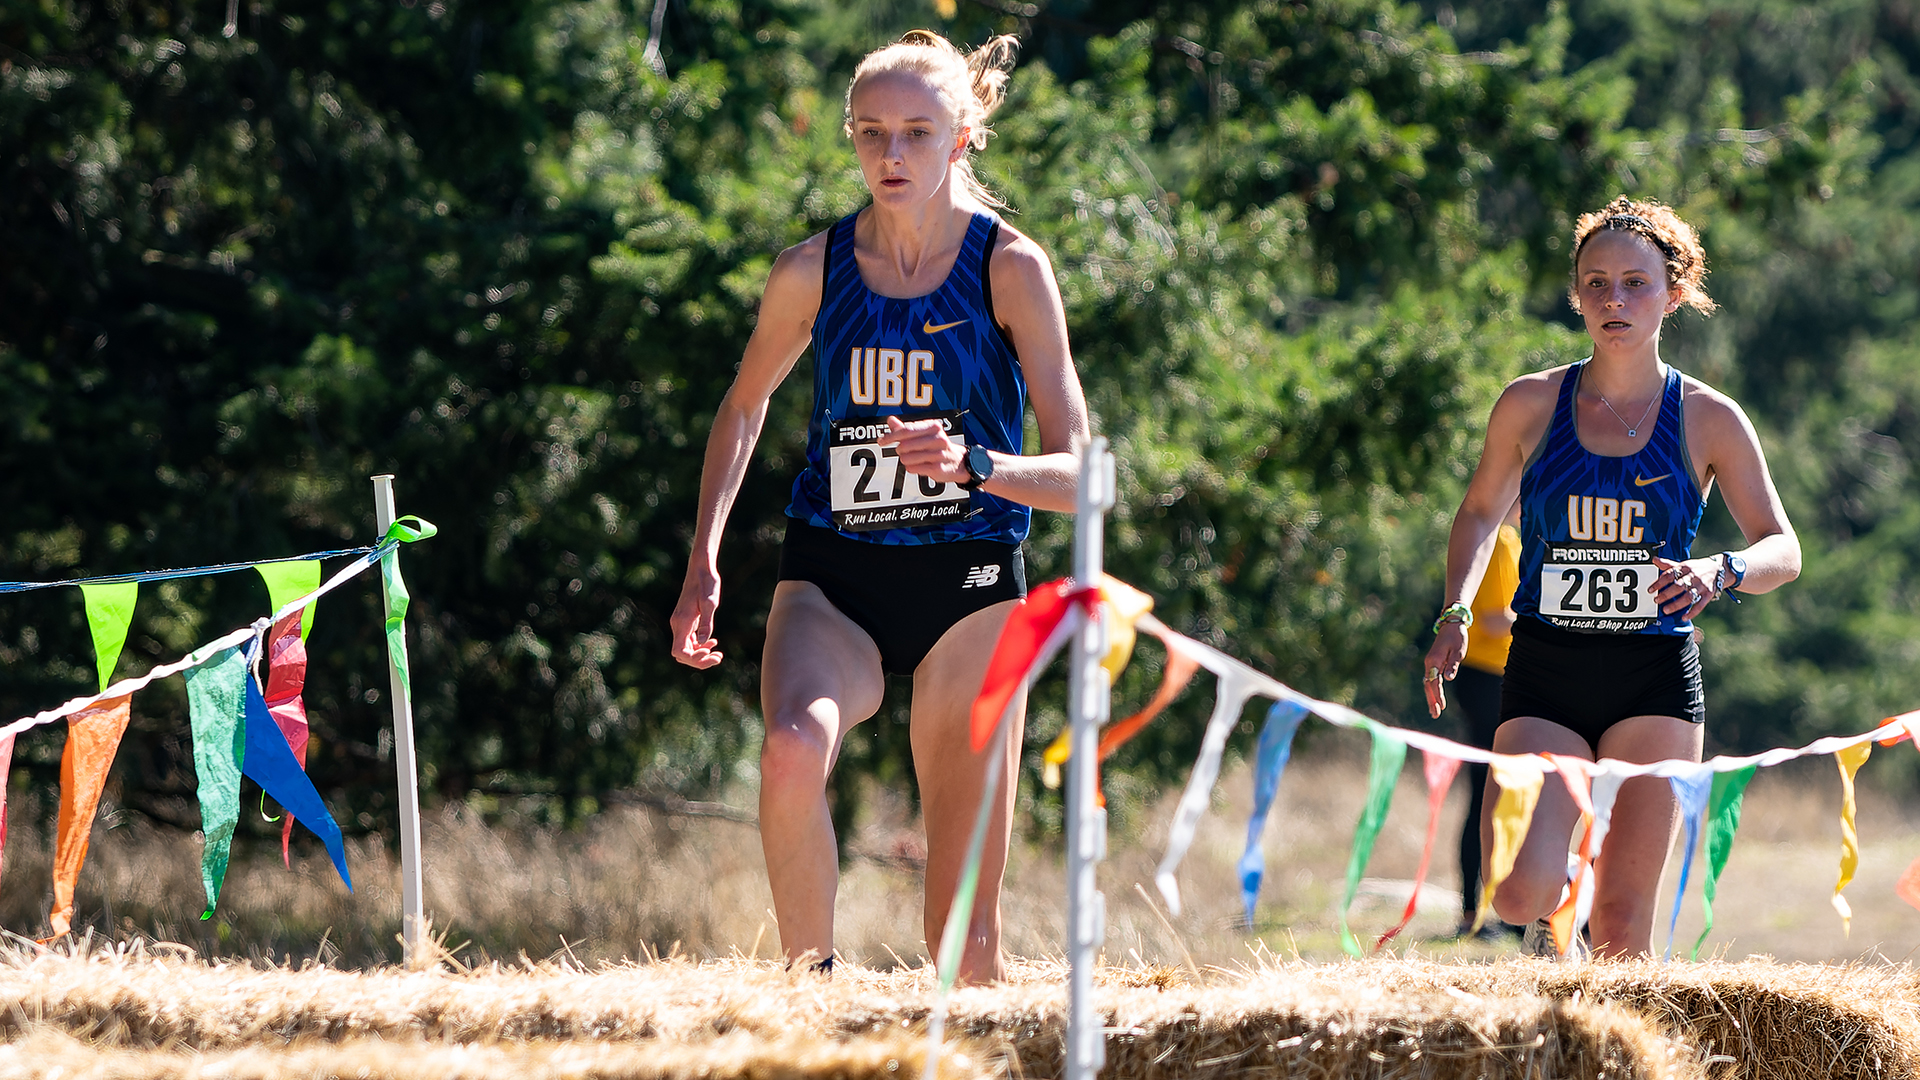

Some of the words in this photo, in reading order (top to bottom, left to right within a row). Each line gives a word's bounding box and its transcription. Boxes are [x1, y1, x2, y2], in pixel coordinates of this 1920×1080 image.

[850, 347, 934, 406] UBC
[844, 513, 867, 526] Run
[868, 509, 898, 523] Local.
[900, 507, 929, 521] Shop
[931, 502, 960, 516] Local.
[1568, 494, 1646, 544] UBC
[1552, 547, 1651, 562] FRONTRUNNERS
[1560, 567, 1639, 613] 263
[1551, 617, 1569, 627] Run
[1596, 619, 1623, 632] Shop
